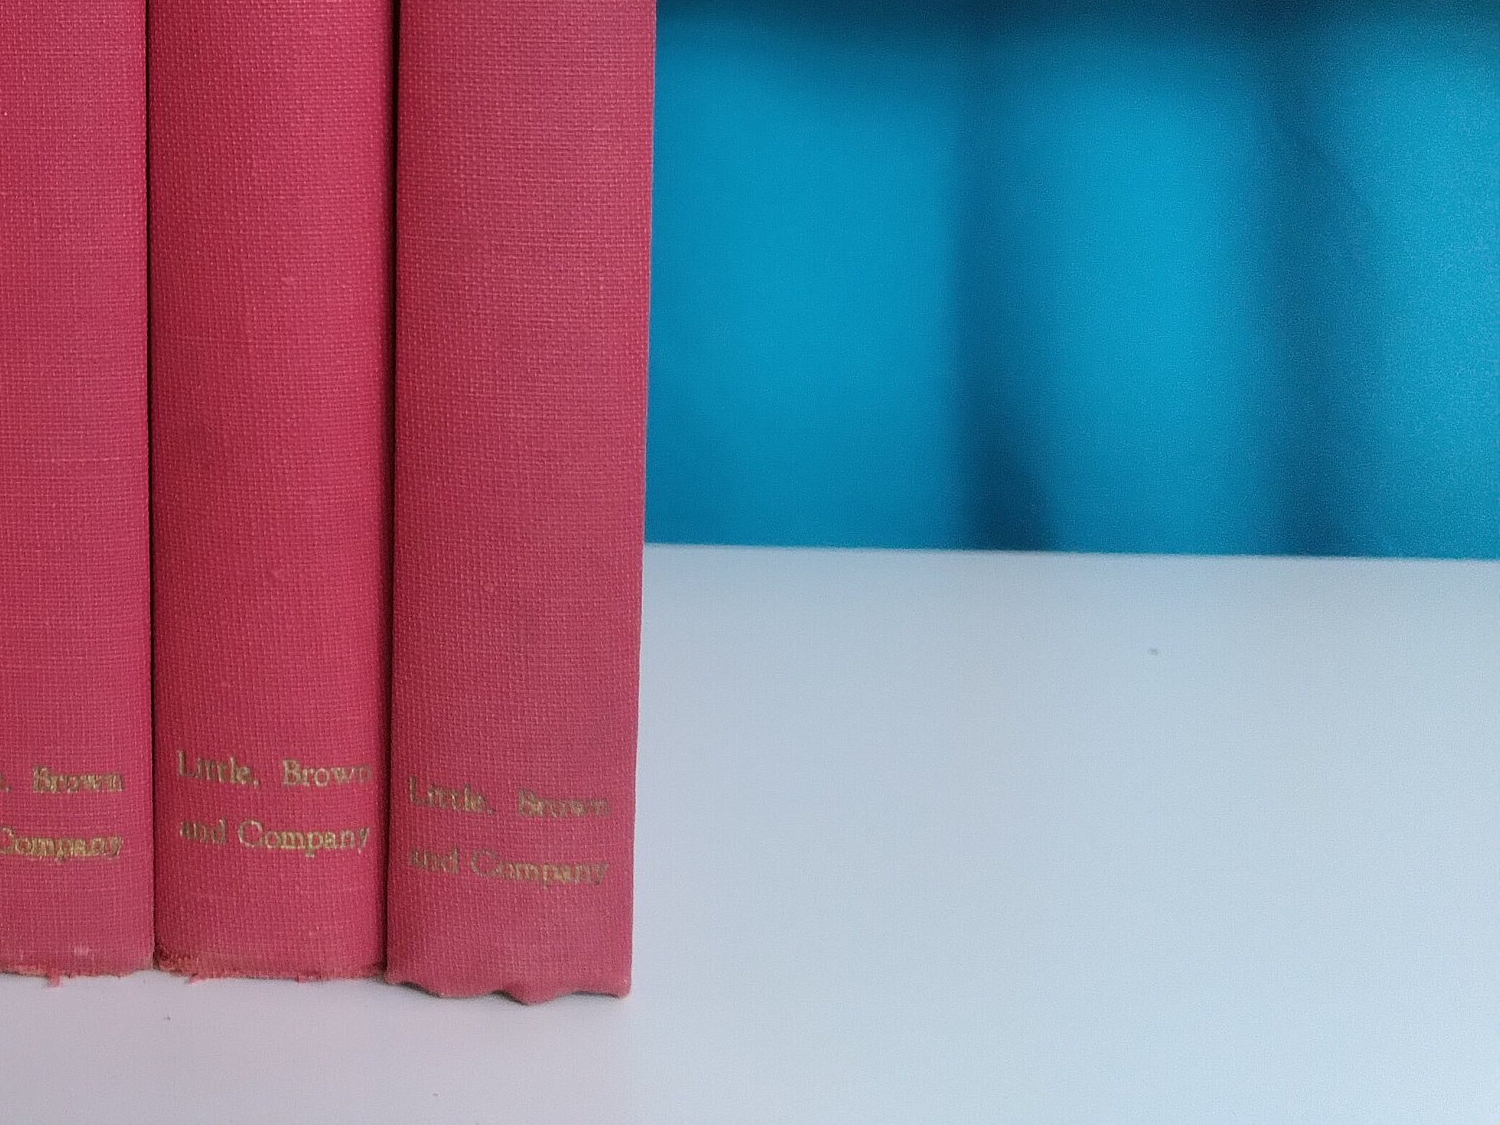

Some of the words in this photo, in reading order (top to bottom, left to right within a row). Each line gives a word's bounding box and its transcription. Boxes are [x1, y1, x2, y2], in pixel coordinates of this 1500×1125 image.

[31, 764, 125, 795] Brown
[176, 750, 259, 788] Little,
[281, 759, 372, 788] Brown
[517, 787, 611, 820] Brown
[179, 817, 227, 846] and
[237, 820, 371, 858] Company
[470, 848, 611, 887] Company
